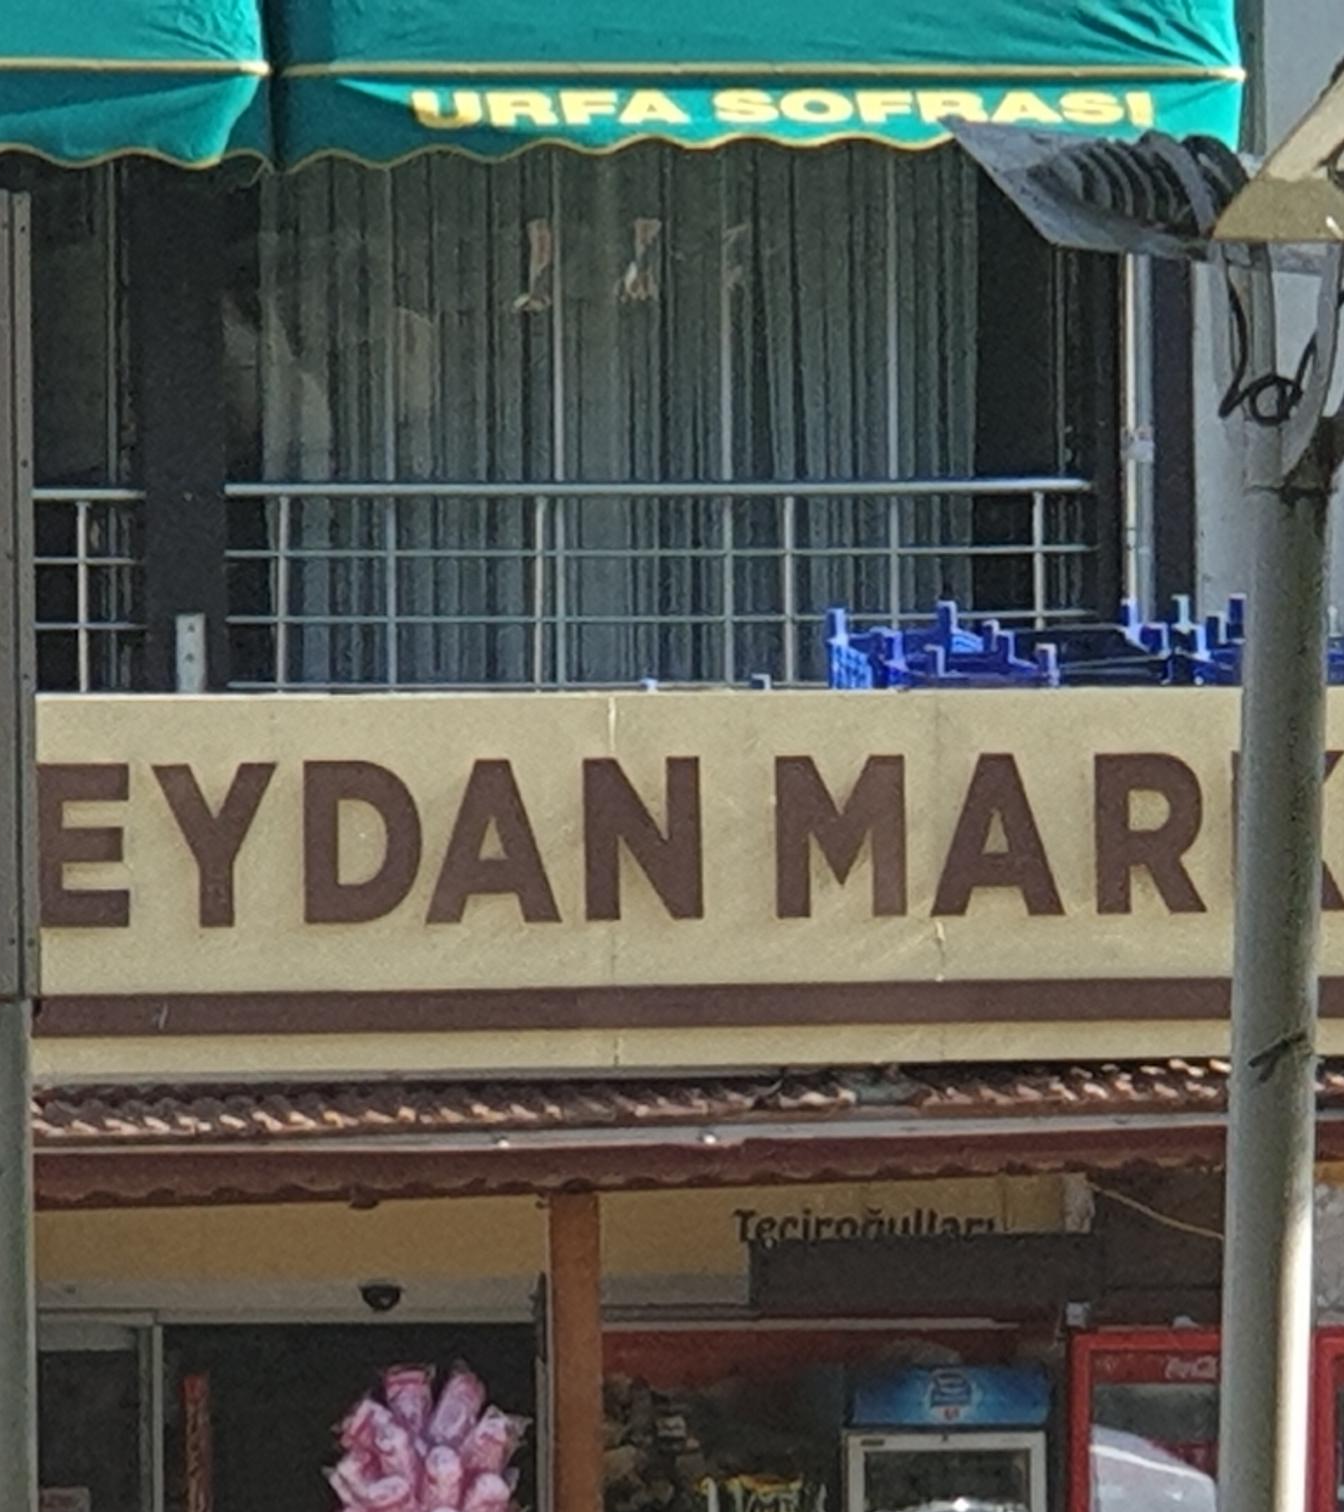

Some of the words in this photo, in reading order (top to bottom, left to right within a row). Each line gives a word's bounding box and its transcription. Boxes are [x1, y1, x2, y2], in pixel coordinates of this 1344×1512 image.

[410, 88, 690, 130] URFA
[713, 88, 1154, 129] SOFRASI
[38, 755, 705, 930] EYDAN
